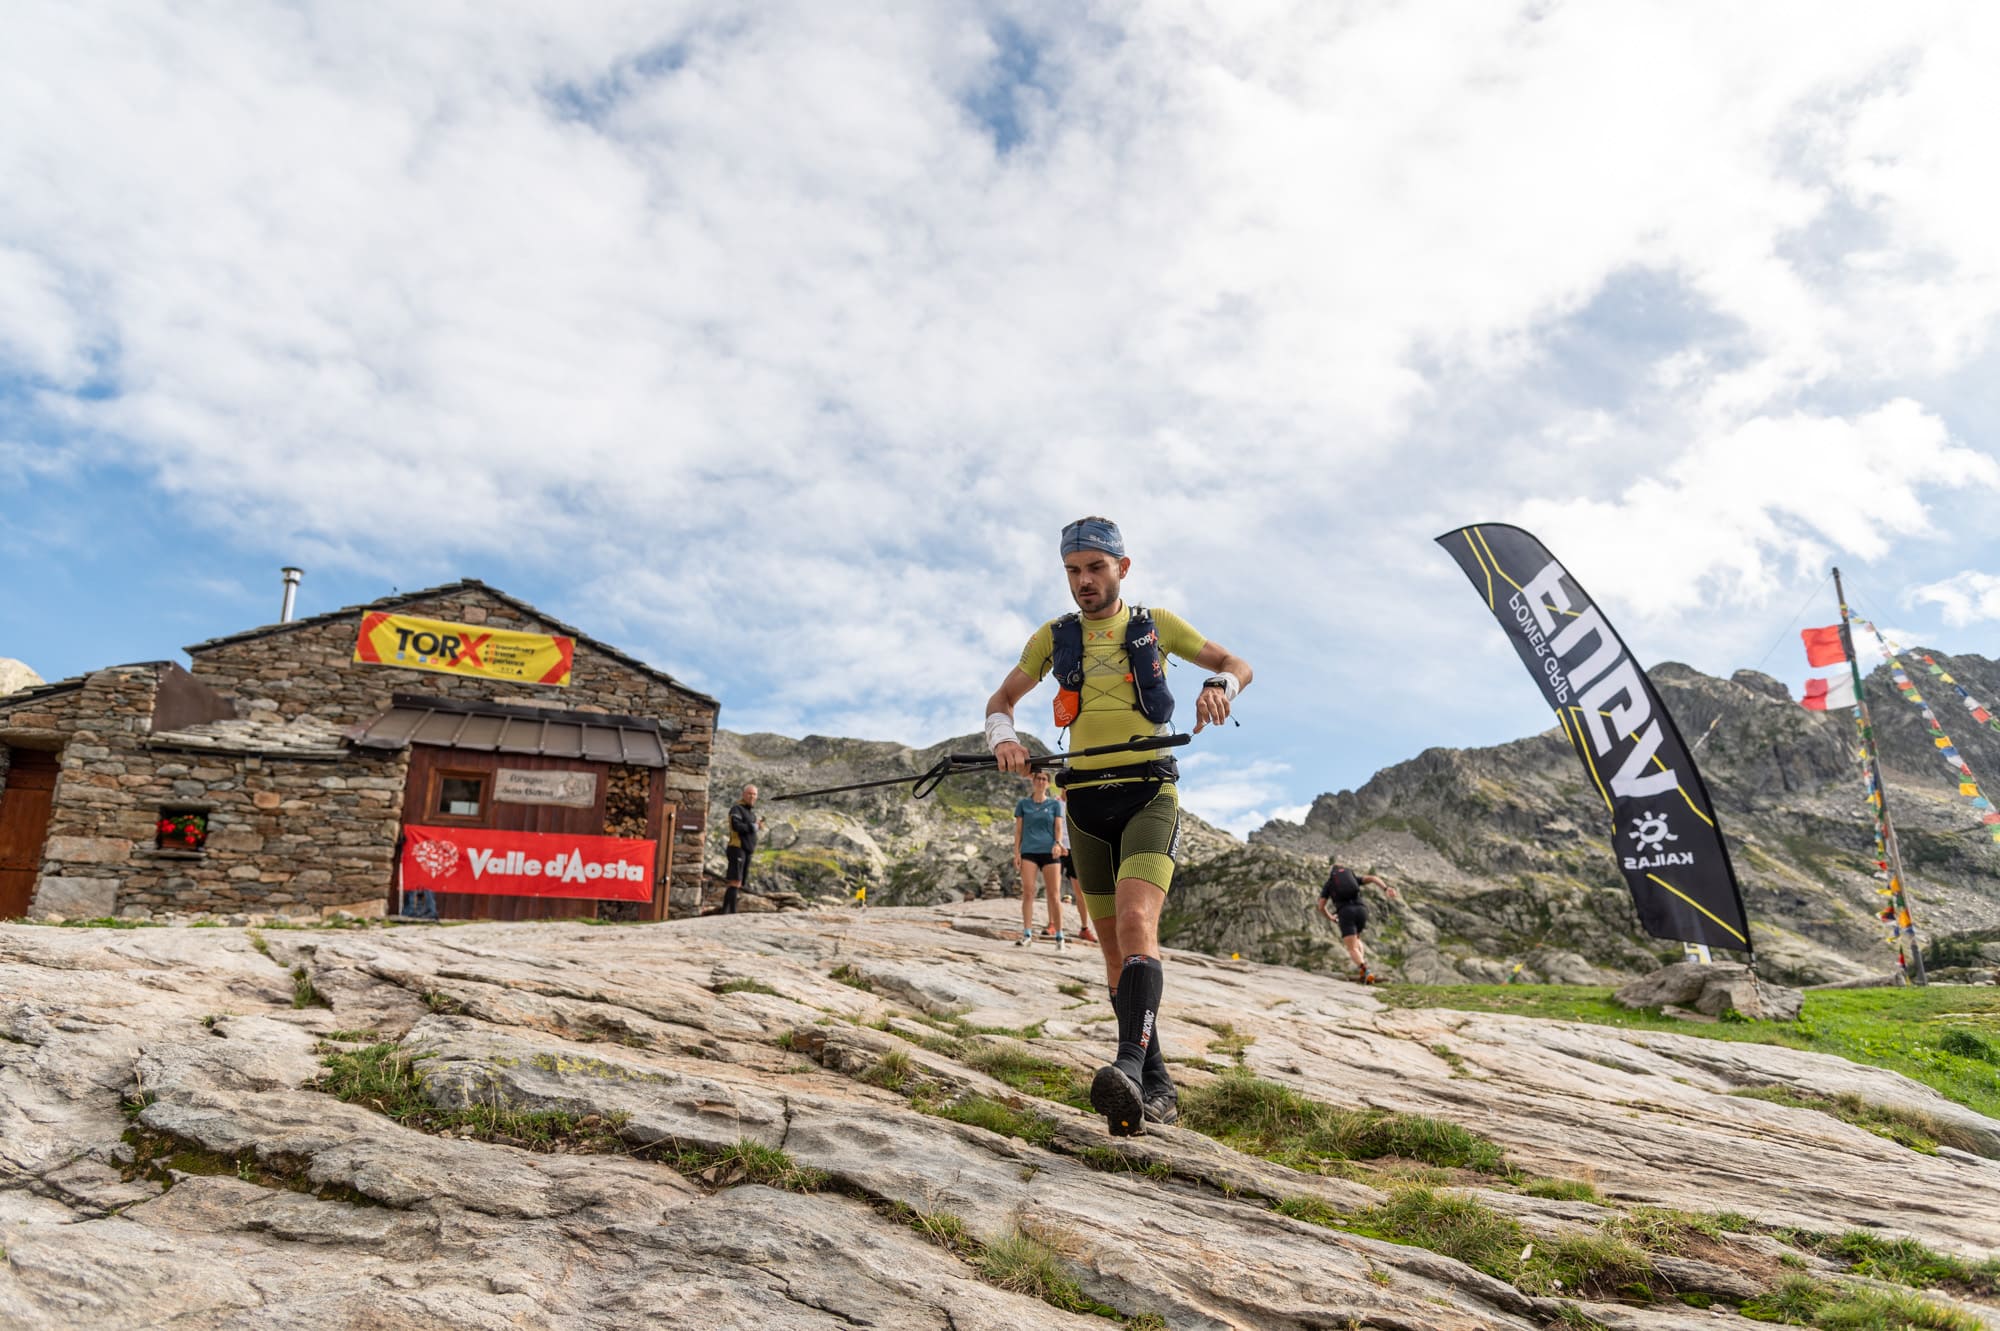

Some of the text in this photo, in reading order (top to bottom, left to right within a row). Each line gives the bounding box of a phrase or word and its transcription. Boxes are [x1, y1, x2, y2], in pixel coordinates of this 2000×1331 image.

[396, 628, 493, 667] TORX
[1132, 629, 1158, 649] TORX
[467, 848, 644, 884] Valle d'Aosta
